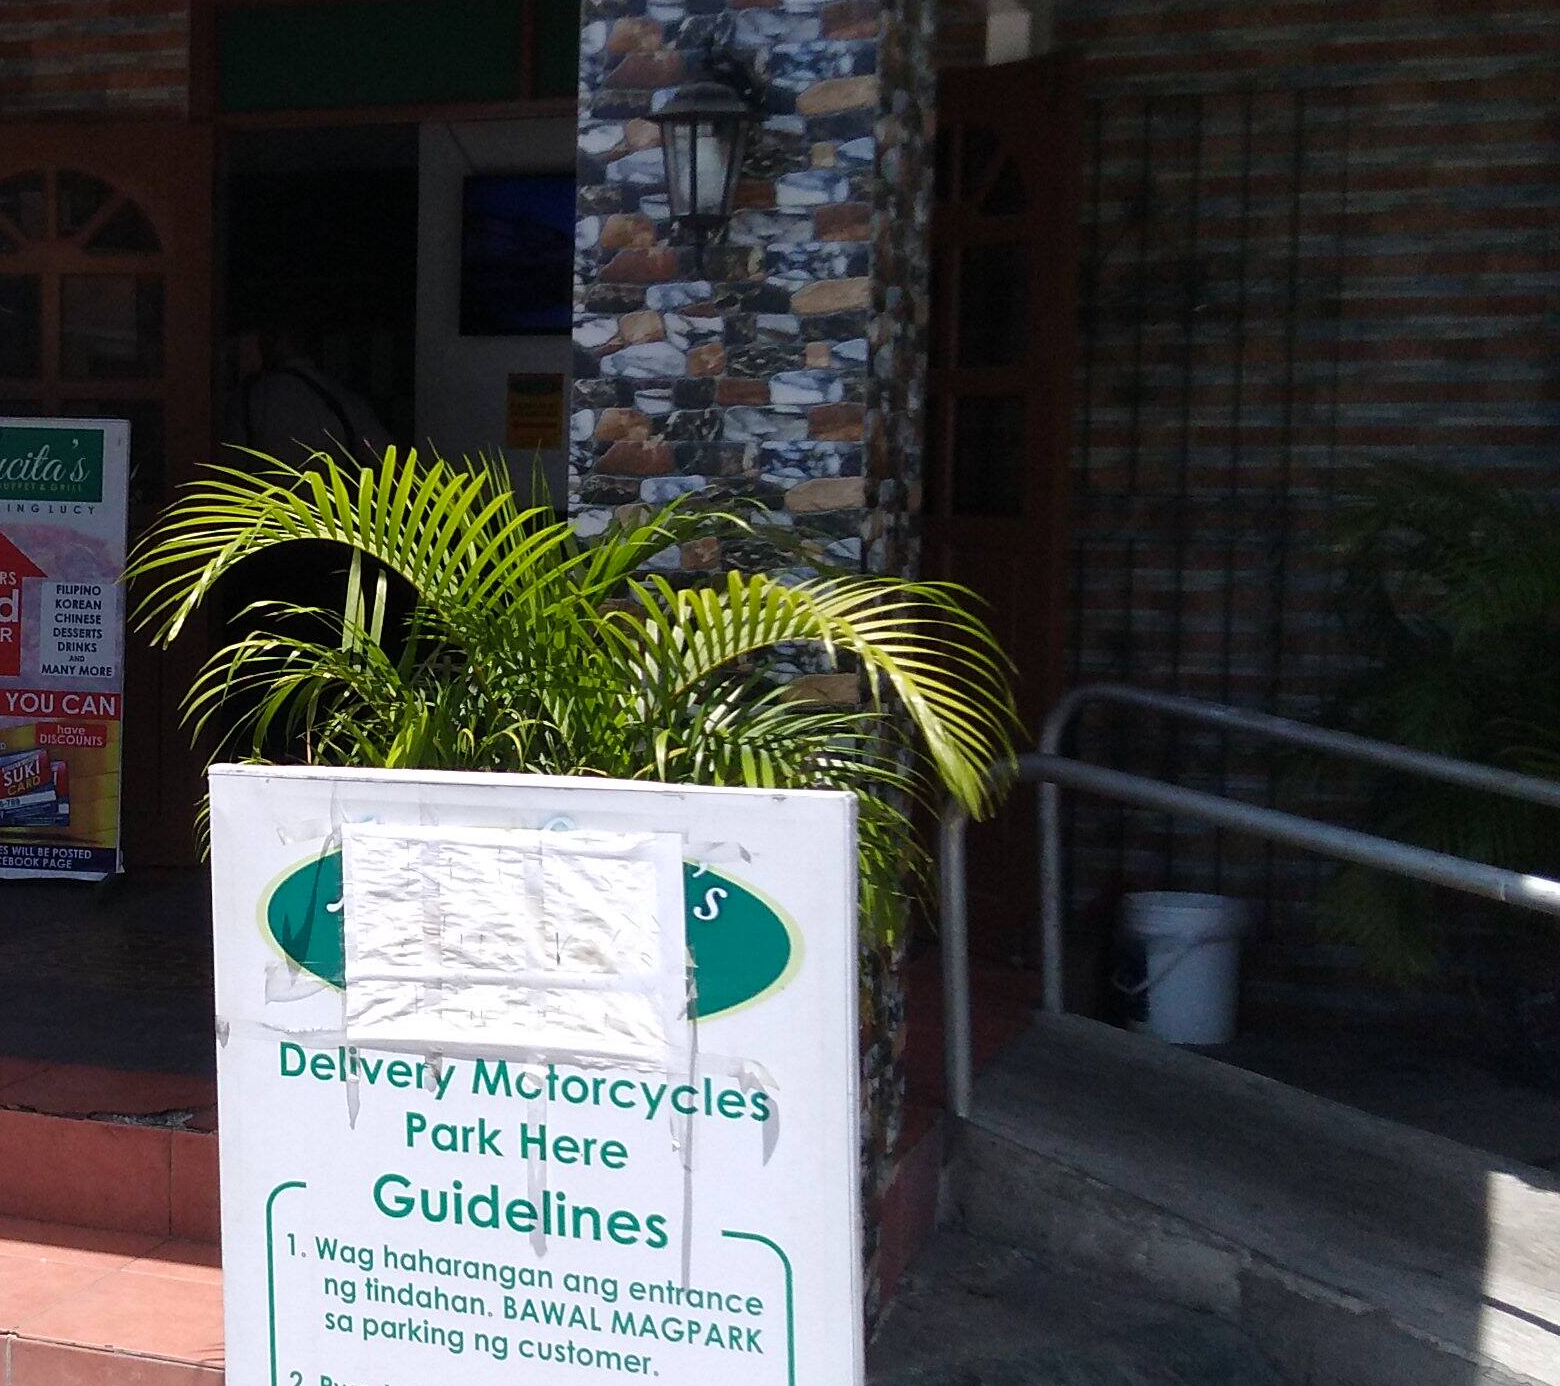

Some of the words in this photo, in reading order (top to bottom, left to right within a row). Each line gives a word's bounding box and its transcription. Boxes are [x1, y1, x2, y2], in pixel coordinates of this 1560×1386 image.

[56, 585, 101, 596] FILIPINO
[55, 600, 101, 610] KOREAN
[55, 614, 101, 625] CHINESE
[53, 627, 102, 639] DESSERTS
[58, 642, 97, 653] DRINKS
[42, 664, 76, 676] MANY
[78, 666, 112, 677] MORE
[6, 693, 54, 713] YOU
[62, 695, 116, 716] CAN
[57, 725, 85, 735] have
[40, 734, 104, 747] DISCOUNTS
[4, 760, 40, 787] SUKI
[7, 776, 41, 796] CARD
[12, 845, 35, 857] WILL
[38, 847, 50, 858] BE
[54, 848, 92, 859] POSTED
[43, 858, 73, 869] PAGE
[279, 1043, 455, 1100] Delivery
[472, 1057, 771, 1122] Motorcycles
[405, 1111, 504, 1158] Park
[521, 1125, 629, 1170] Here
[373, 1173, 669, 1250] Guidelines
[287, 1233, 306, 1258] 1.
[315, 1236, 374, 1271] Wag
[384, 1245, 553, 1289] haharangan
[563, 1272, 618, 1302] ang
[629, 1281, 763, 1317] entrance
[324, 1274, 356, 1303] ng
[365, 1280, 493, 1318] tindahan.
[503, 1296, 602, 1332] BAWAL
[611, 1311, 763, 1354] MAGPARK
[325, 1311, 354, 1333] sa
[363, 1316, 464, 1354] parking
[474, 1332, 508, 1360] ng
[518, 1338, 659, 1377] customer.
